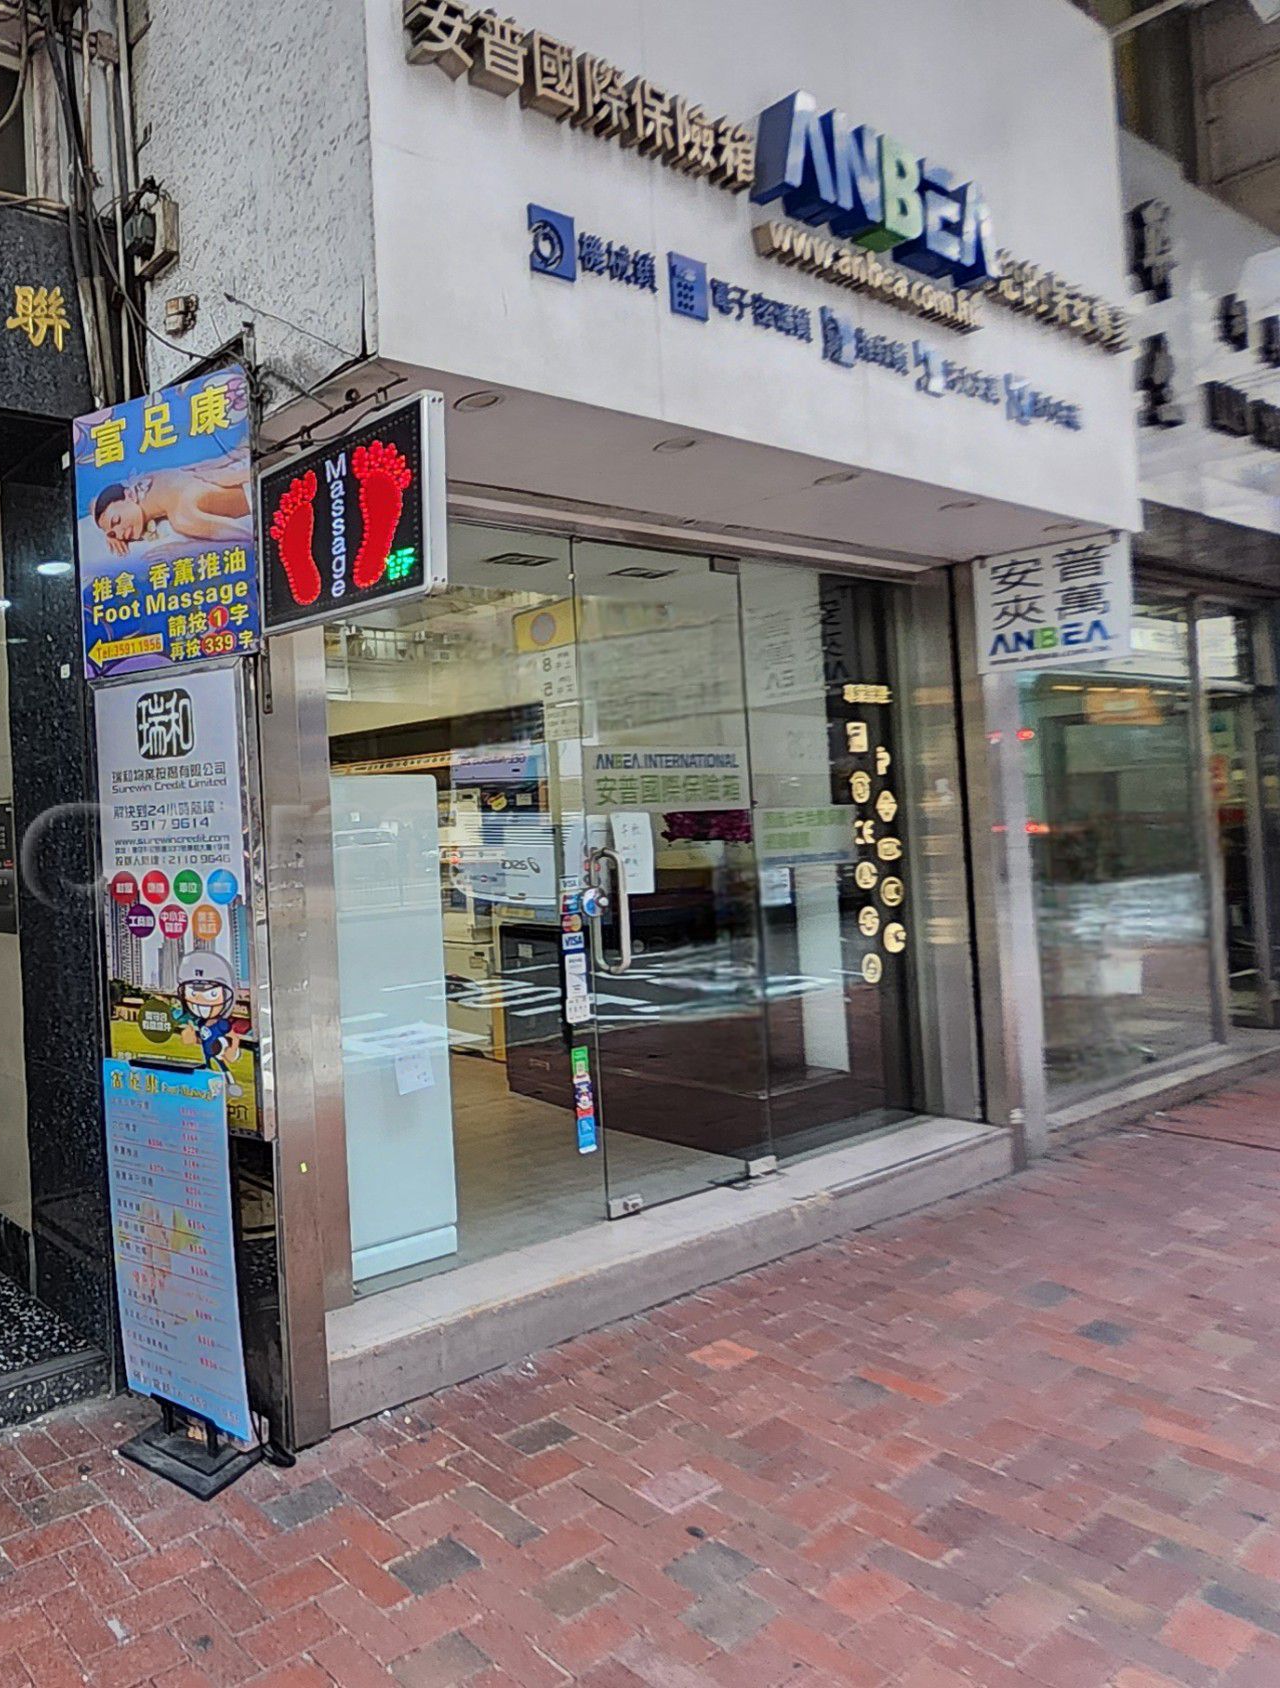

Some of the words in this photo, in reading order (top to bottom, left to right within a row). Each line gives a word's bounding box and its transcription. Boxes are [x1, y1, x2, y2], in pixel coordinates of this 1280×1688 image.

[752, 89, 1004, 288] ANBEA
[90, 383, 230, 468] 富足康
[325, 452, 348, 598] Massage
[92, 572, 136, 602] 推拿
[92, 599, 141, 626] Foot
[146, 581, 248, 613] Massage
[988, 619, 1109, 656] ANBEA
[112, 785, 152, 794] Surewin
[154, 781, 186, 791] Credit
[188, 778, 227, 788] Limited
[171, 817, 209, 829] 9614
[565, 933, 582, 946] VISA
